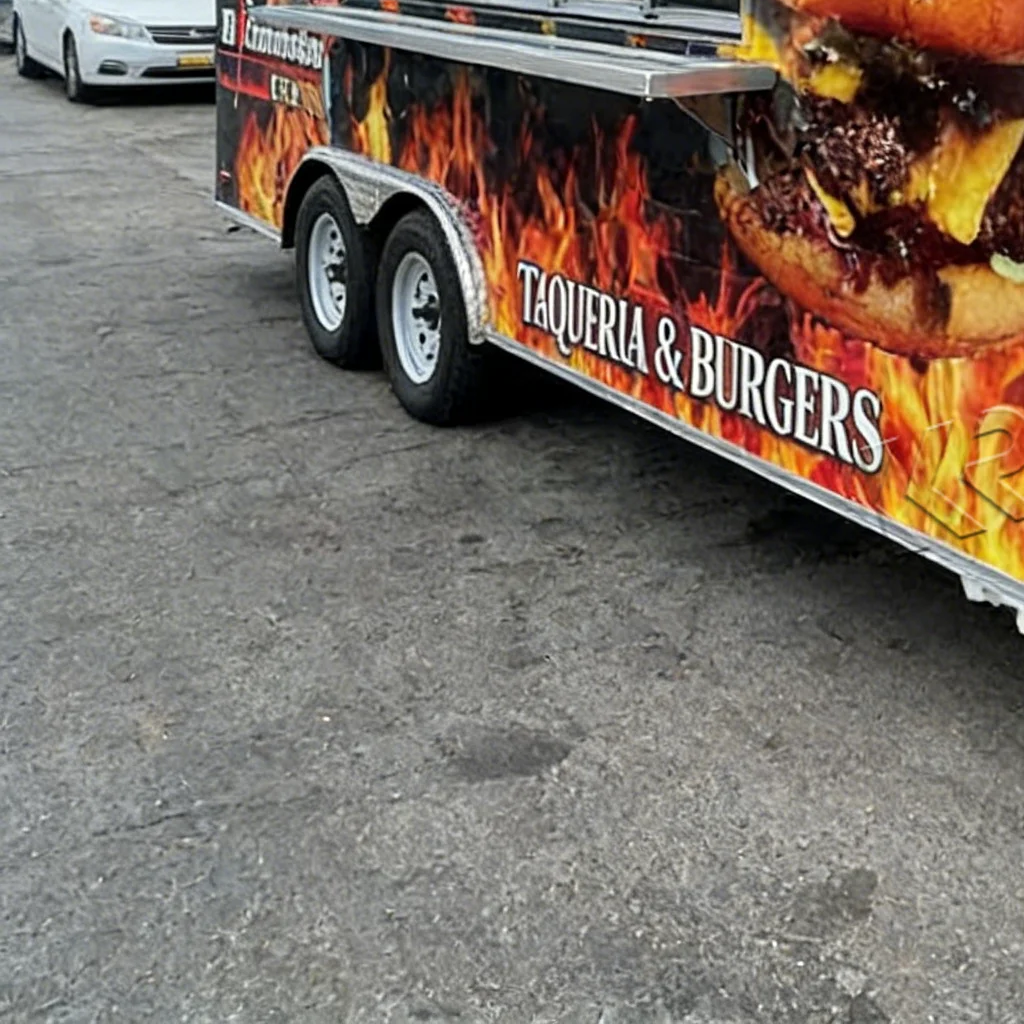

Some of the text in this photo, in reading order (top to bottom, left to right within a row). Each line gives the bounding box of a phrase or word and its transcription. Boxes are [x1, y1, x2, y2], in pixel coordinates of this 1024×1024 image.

[517, 262, 884, 474] TAQUERIA & BURGERS
